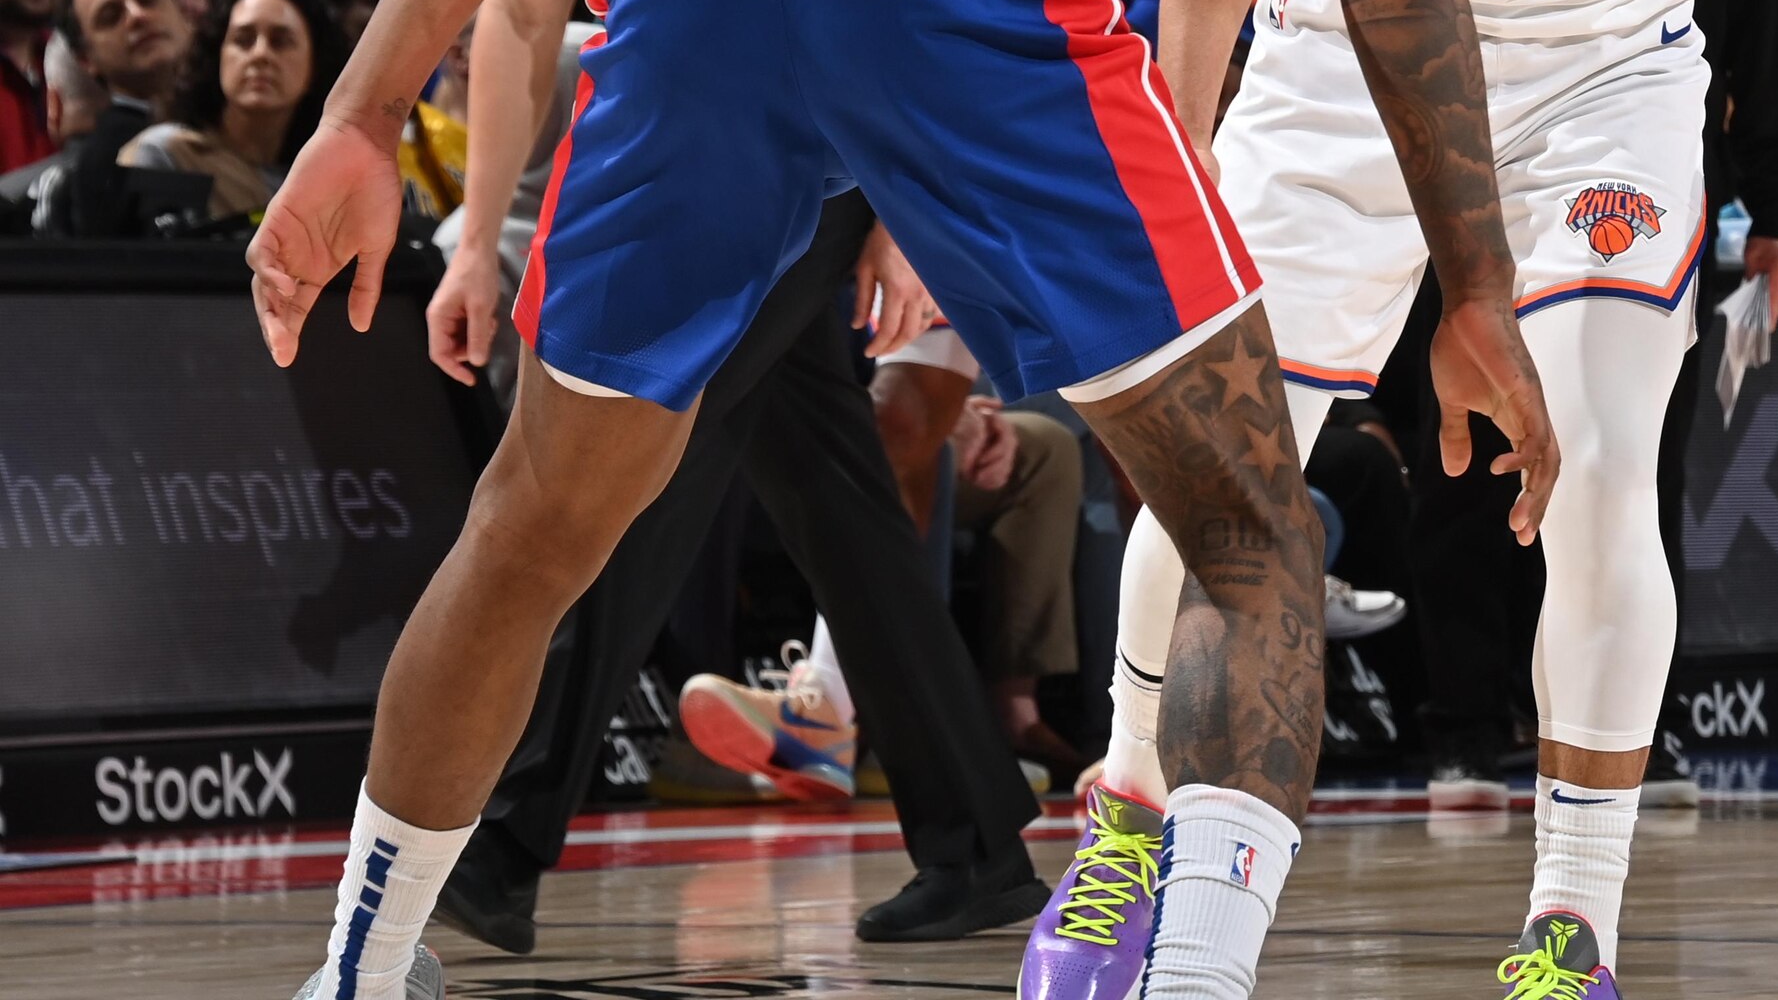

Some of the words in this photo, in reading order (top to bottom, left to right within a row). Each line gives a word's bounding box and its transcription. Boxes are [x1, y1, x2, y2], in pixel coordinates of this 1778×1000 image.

[1565, 187, 1661, 239] KNICKS
[1596, 182, 1616, 190] NEW
[1617, 182, 1638, 193] YORK
[133, 447, 412, 567] inspires
[1691, 678, 1769, 738] ckX
[95, 746, 297, 825] StockX
